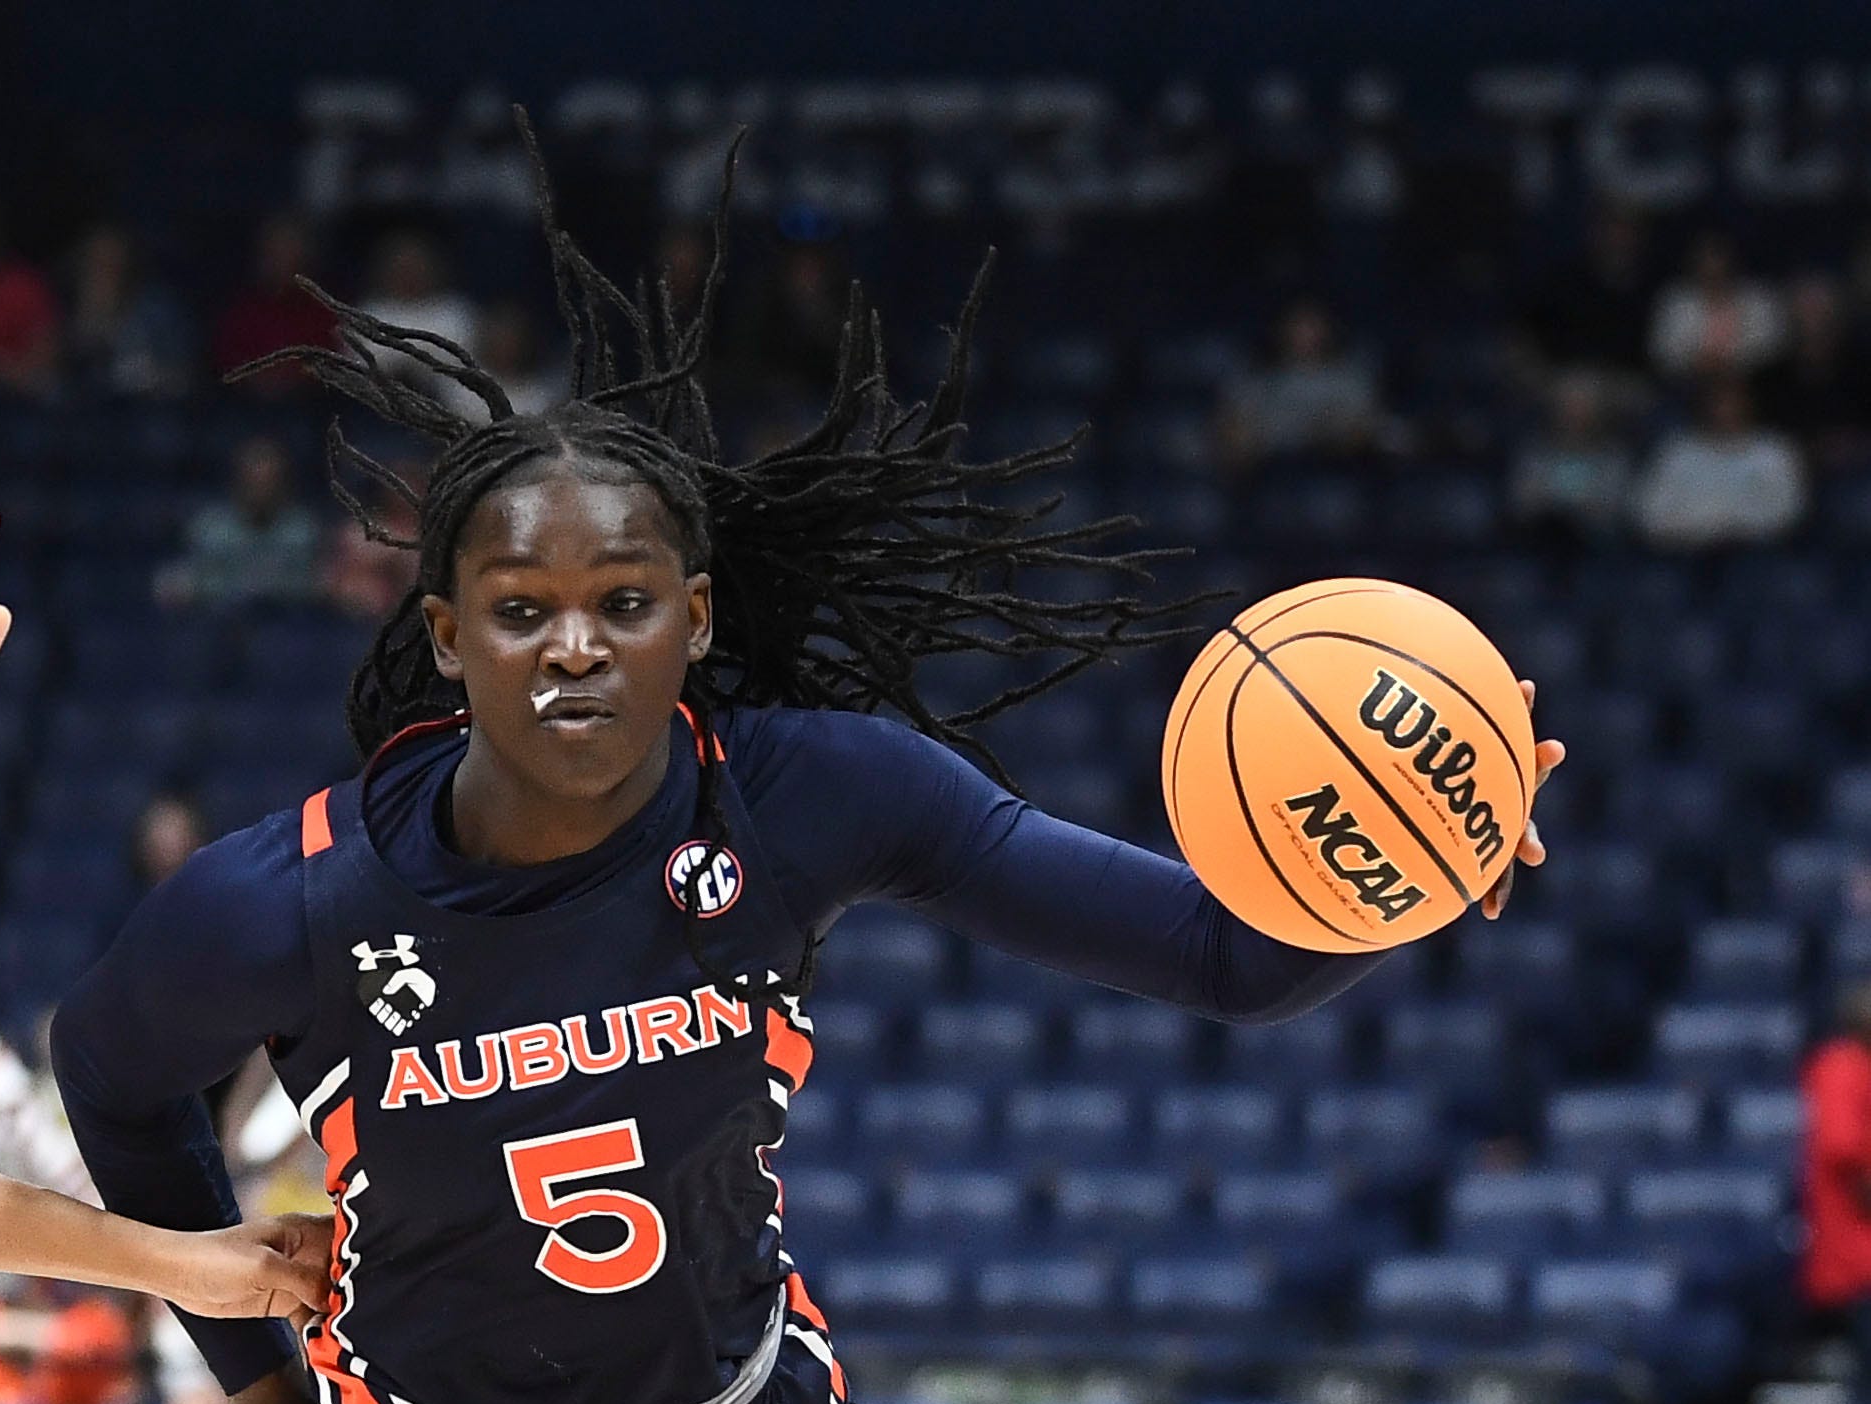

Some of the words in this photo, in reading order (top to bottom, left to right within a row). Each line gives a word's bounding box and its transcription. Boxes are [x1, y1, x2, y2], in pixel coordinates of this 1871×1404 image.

[1359, 668, 1505, 874] Wilson
[1284, 783, 1427, 923] NCAA
[379, 968, 755, 1110] AUBURN
[502, 1117, 667, 1294] 5
